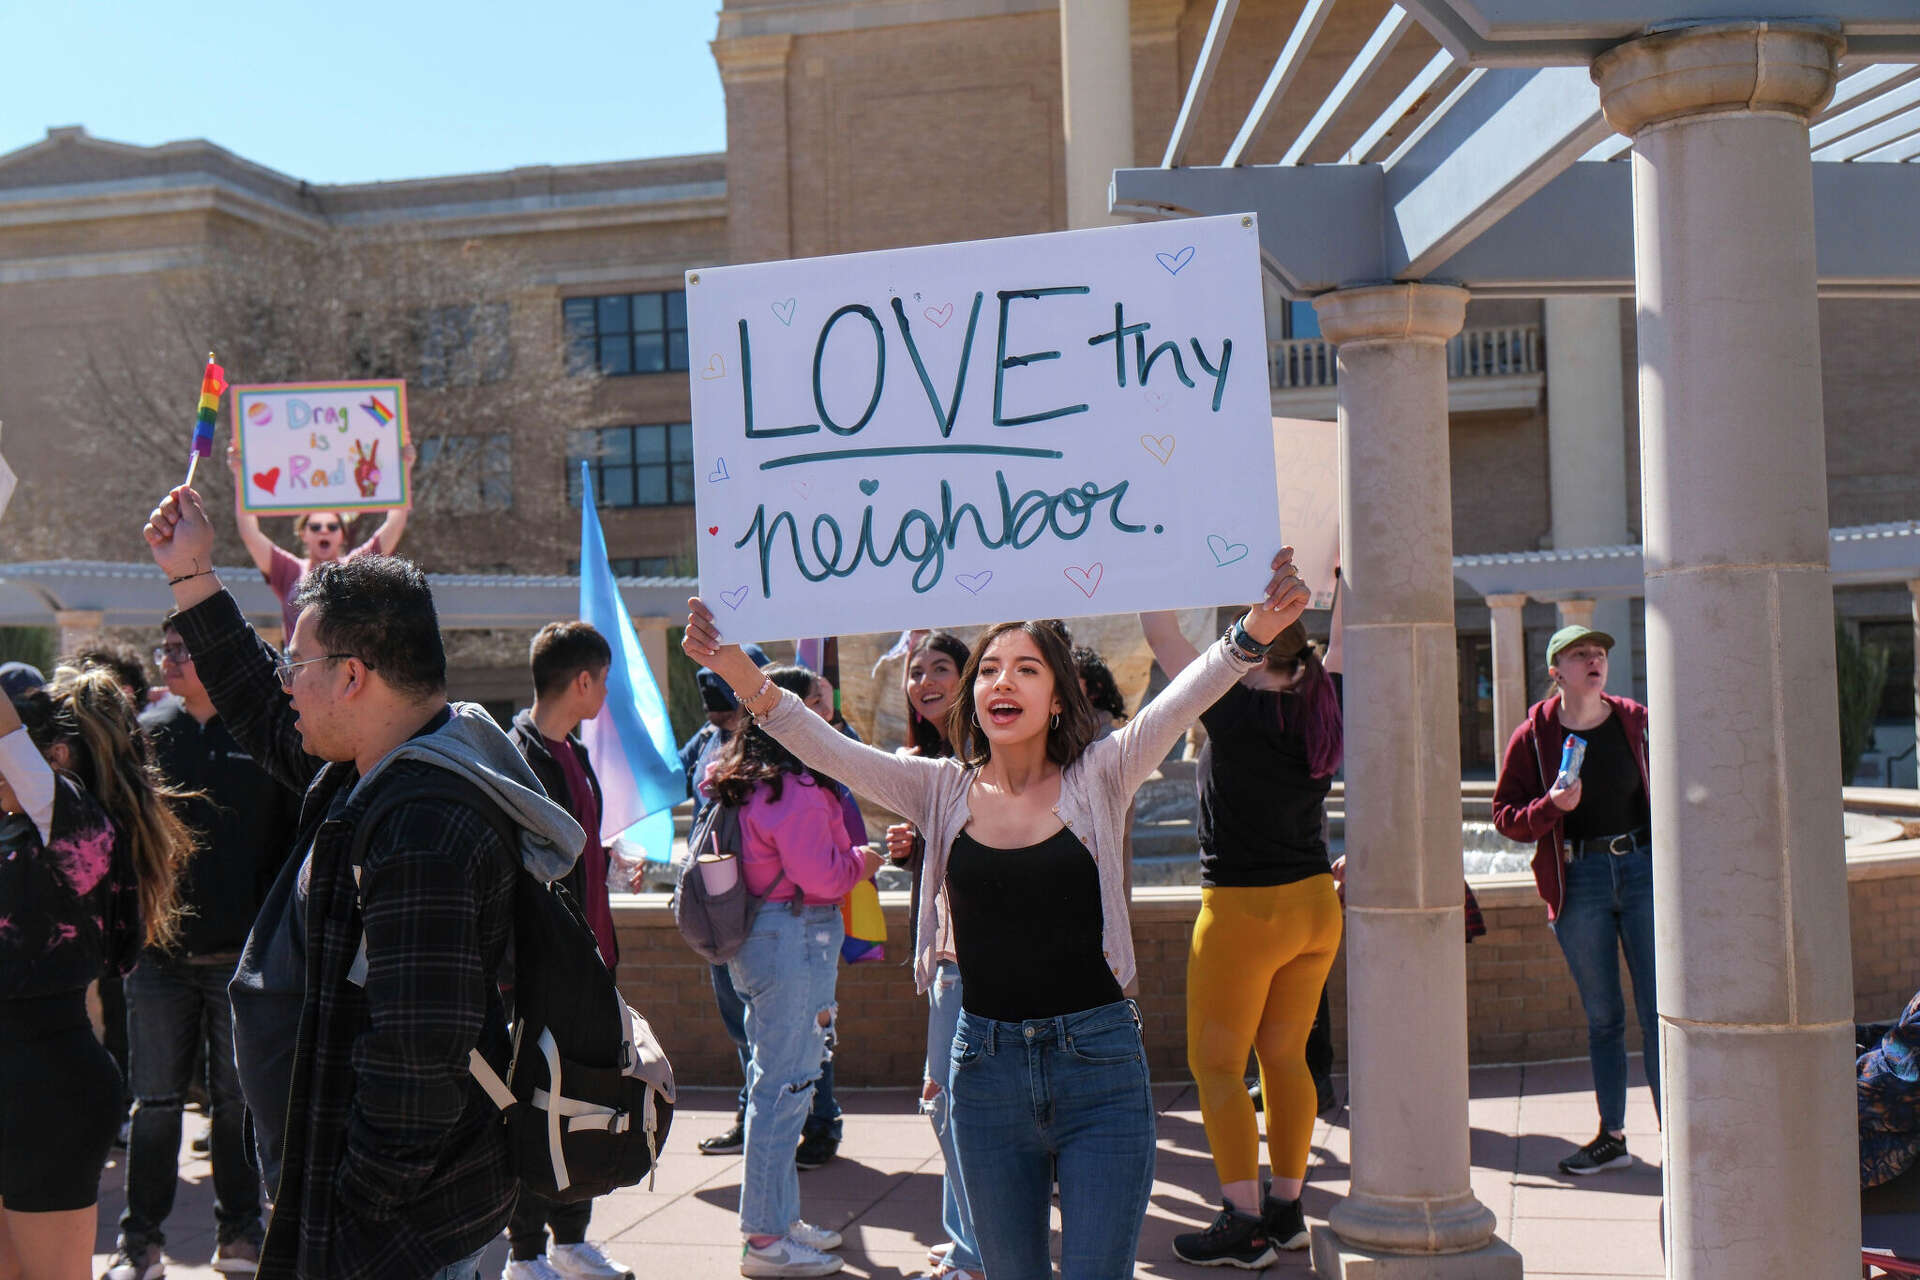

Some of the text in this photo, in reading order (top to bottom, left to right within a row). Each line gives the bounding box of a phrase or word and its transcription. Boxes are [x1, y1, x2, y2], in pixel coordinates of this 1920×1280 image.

[738, 285, 1233, 439] LOVE thy
[285, 398, 349, 433] Drag
[309, 432, 330, 451] is
[288, 455, 346, 489] Rad
[734, 470, 1164, 599] neighbor.
